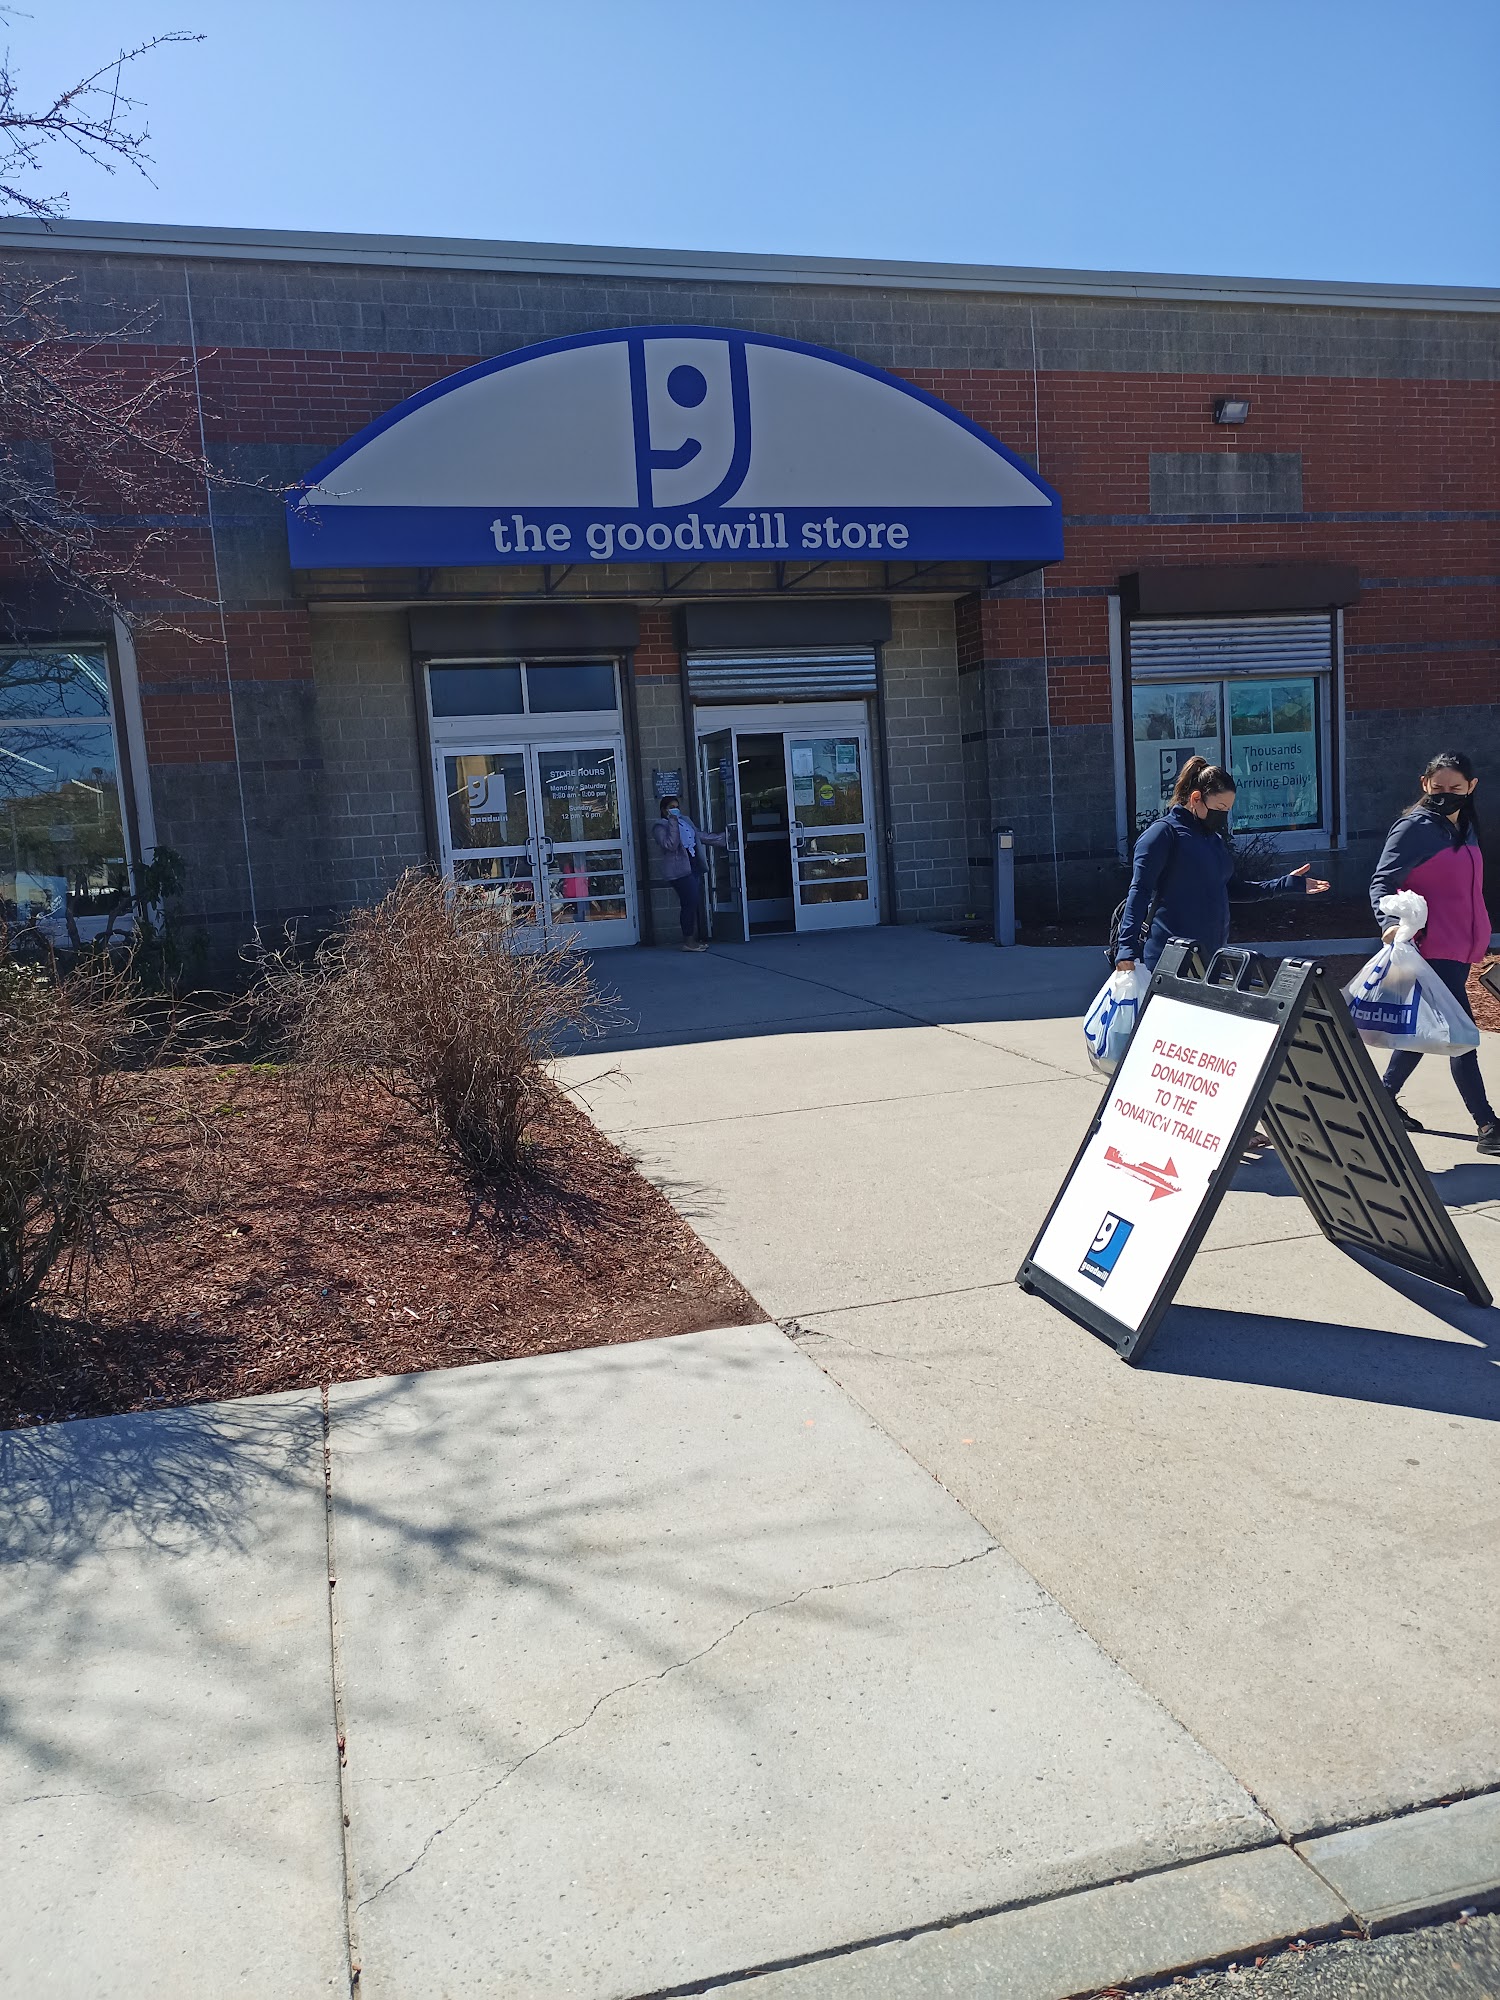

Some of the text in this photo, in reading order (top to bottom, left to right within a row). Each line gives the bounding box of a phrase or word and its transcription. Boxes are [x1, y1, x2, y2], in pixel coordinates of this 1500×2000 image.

[490, 511, 909, 560] the goodwill store
[1242, 744, 1302, 759] Thousands
[550, 768, 605, 778] STORE HOURS
[1251, 759, 1296, 772] of Items
[1236, 776, 1280, 790] Arriving
[569, 804, 593, 812] Sunday
[470, 814, 508, 826] goodwill
[1152, 1039, 1238, 1077] PLEASE BRING
[1151, 1063, 1220, 1098] DONATIONS
[1155, 1088, 1198, 1117] TO THE
[1114, 1098, 1222, 1153] DONATION TRAILER
[1080, 1261, 1109, 1282] goodwill
